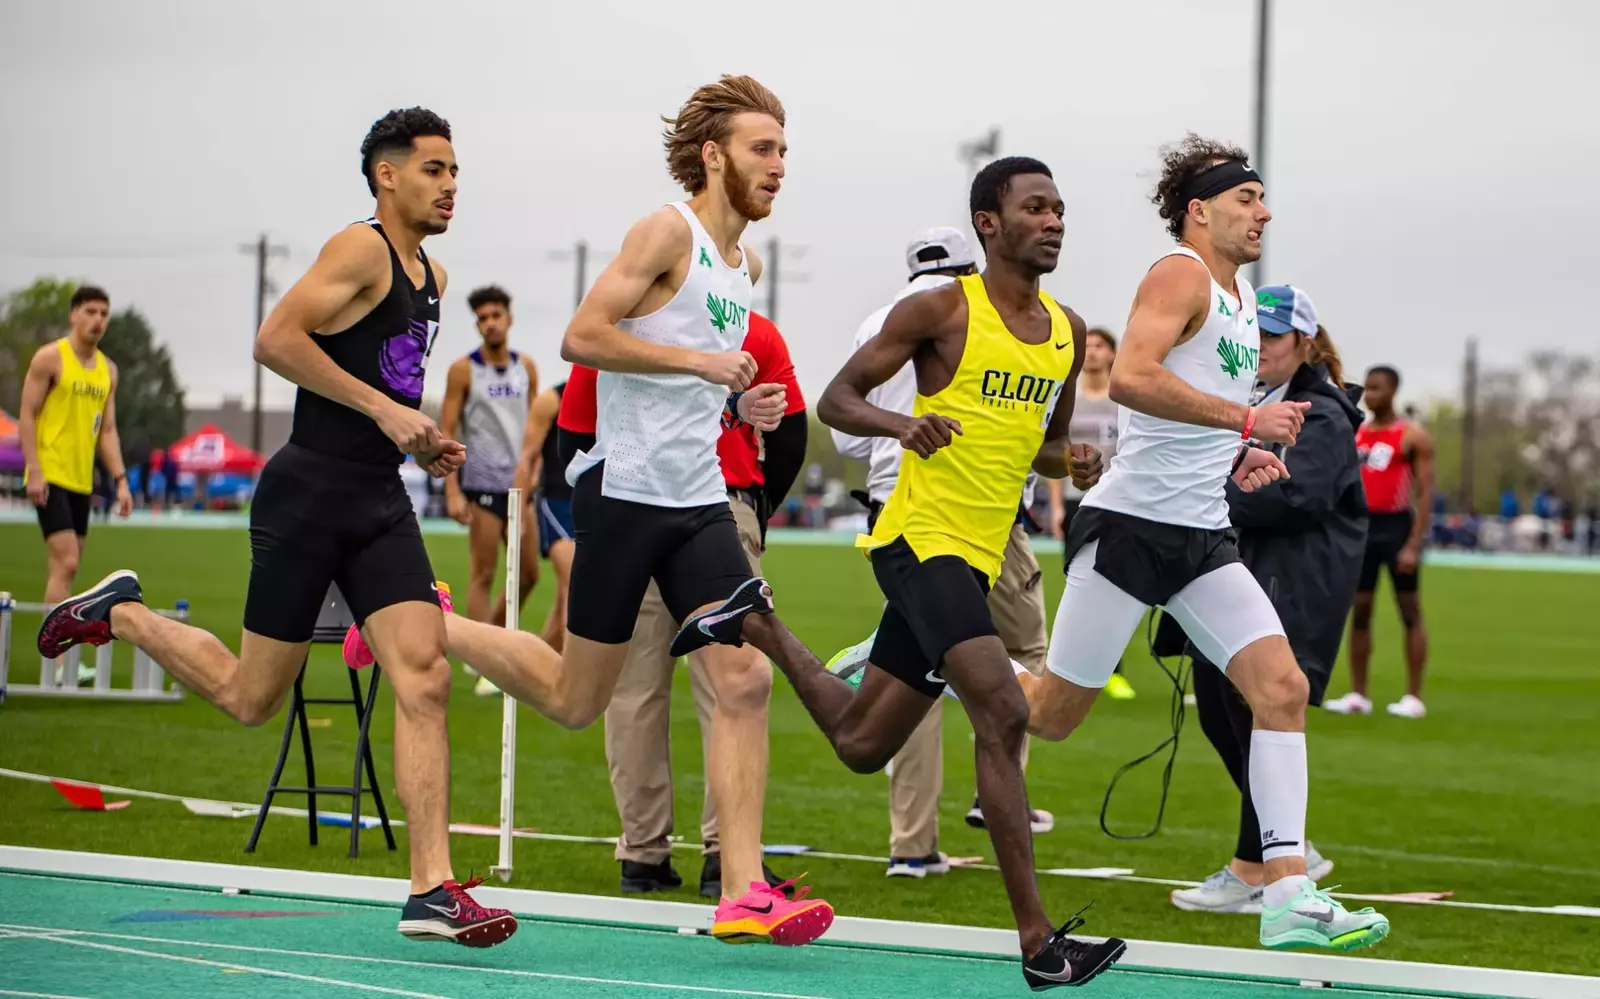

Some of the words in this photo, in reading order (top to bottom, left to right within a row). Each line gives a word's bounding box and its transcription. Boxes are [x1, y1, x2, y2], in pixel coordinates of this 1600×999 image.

[722, 298, 747, 330] UNT
[1235, 342, 1259, 372] UNT
[981, 369, 1056, 404] CLOU
[982, 397, 1016, 411] TRACK
